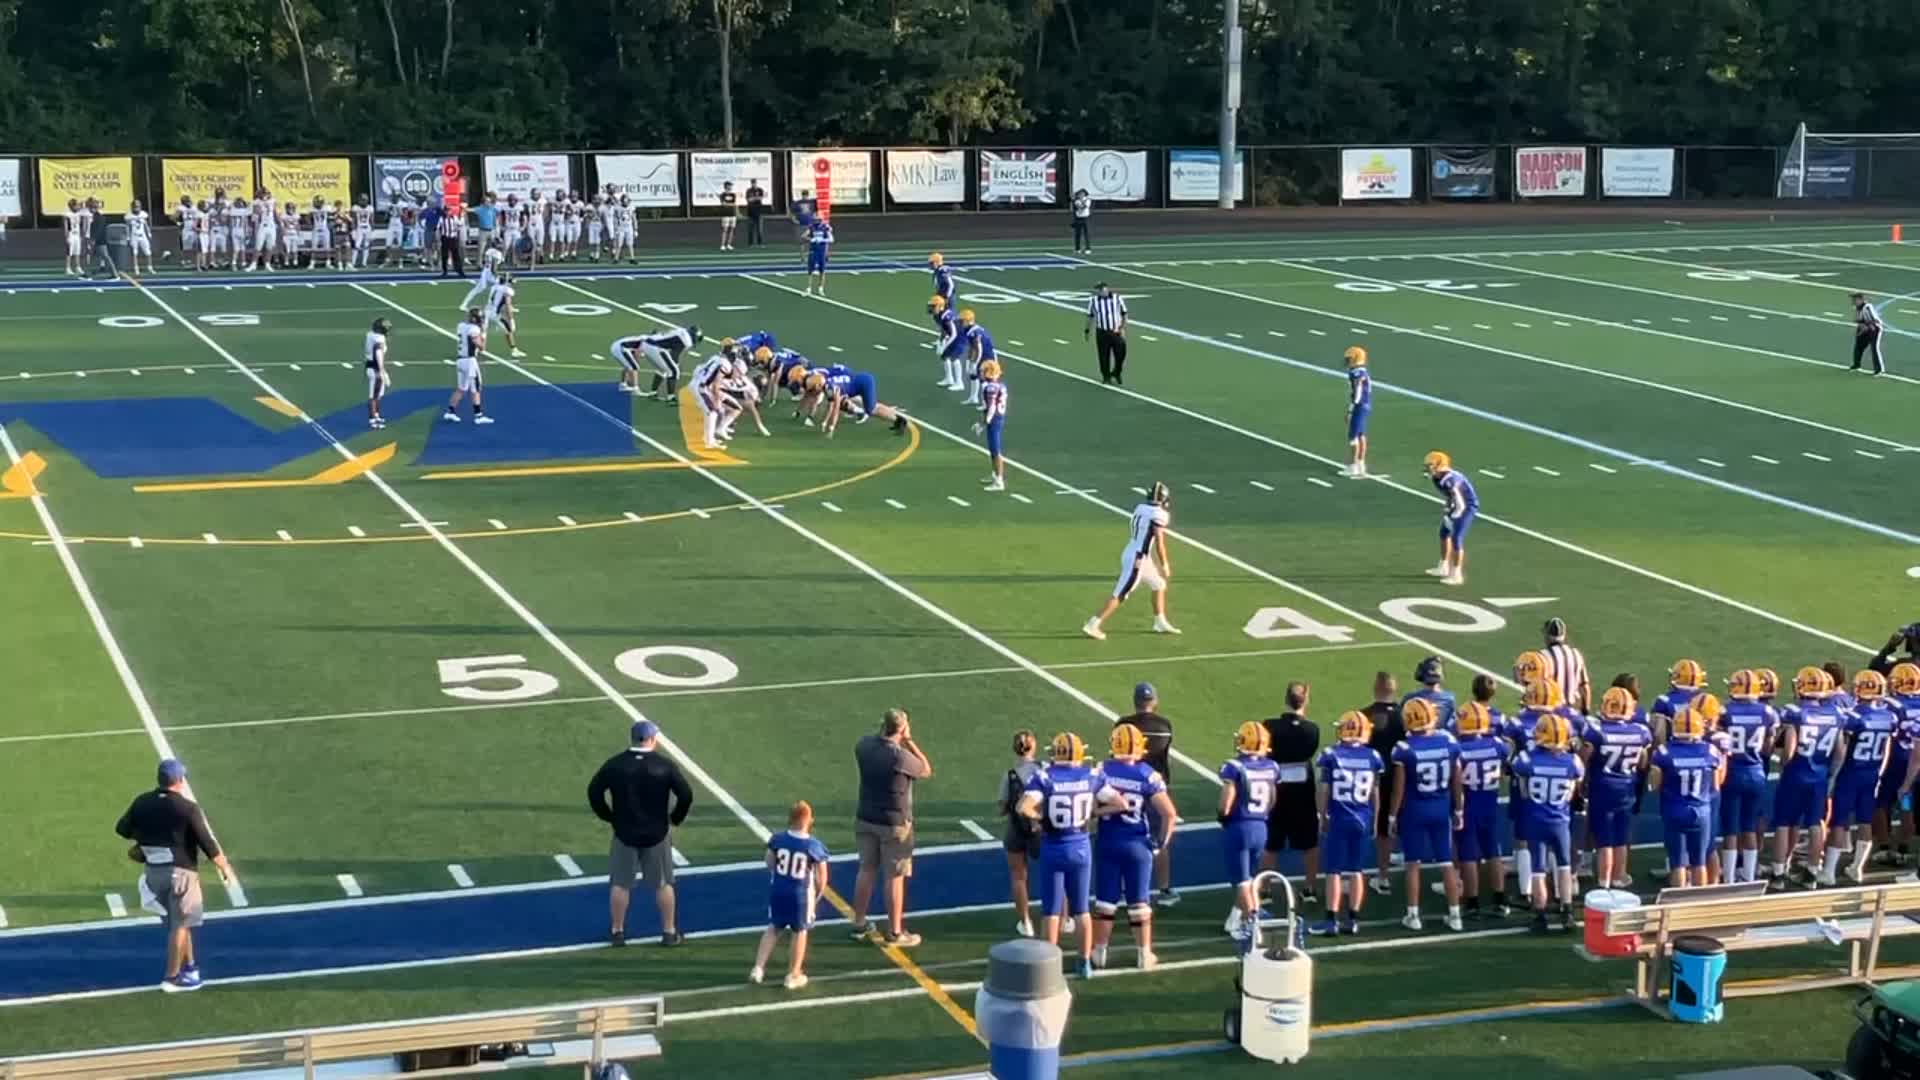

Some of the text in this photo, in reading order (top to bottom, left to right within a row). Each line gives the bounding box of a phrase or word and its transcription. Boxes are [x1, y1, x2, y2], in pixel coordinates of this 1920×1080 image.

[495, 173, 530, 182] MILLER
[890, 163, 926, 186] KMK
[934, 166, 958, 182] Law
[994, 166, 1044, 180] ENGLISH
[1520, 153, 1583, 171] MADISON
[1520, 170, 1559, 190] BOWL
[1243, 597, 1507, 643] 40
[436, 645, 740, 700] 50
[1798, 726, 1839, 757] 54
[1853, 731, 1890, 761] 20
[1462, 759, 1502, 791] 42
[1600, 745, 1643, 776] 72
[1332, 768, 1374, 803] 28
[1416, 761, 1450, 792] 31
[1678, 769, 1703, 799] 11
[1049, 792, 1093, 829] 60
[1247, 780, 1271, 813] 9
[776, 847, 808, 879] 30
